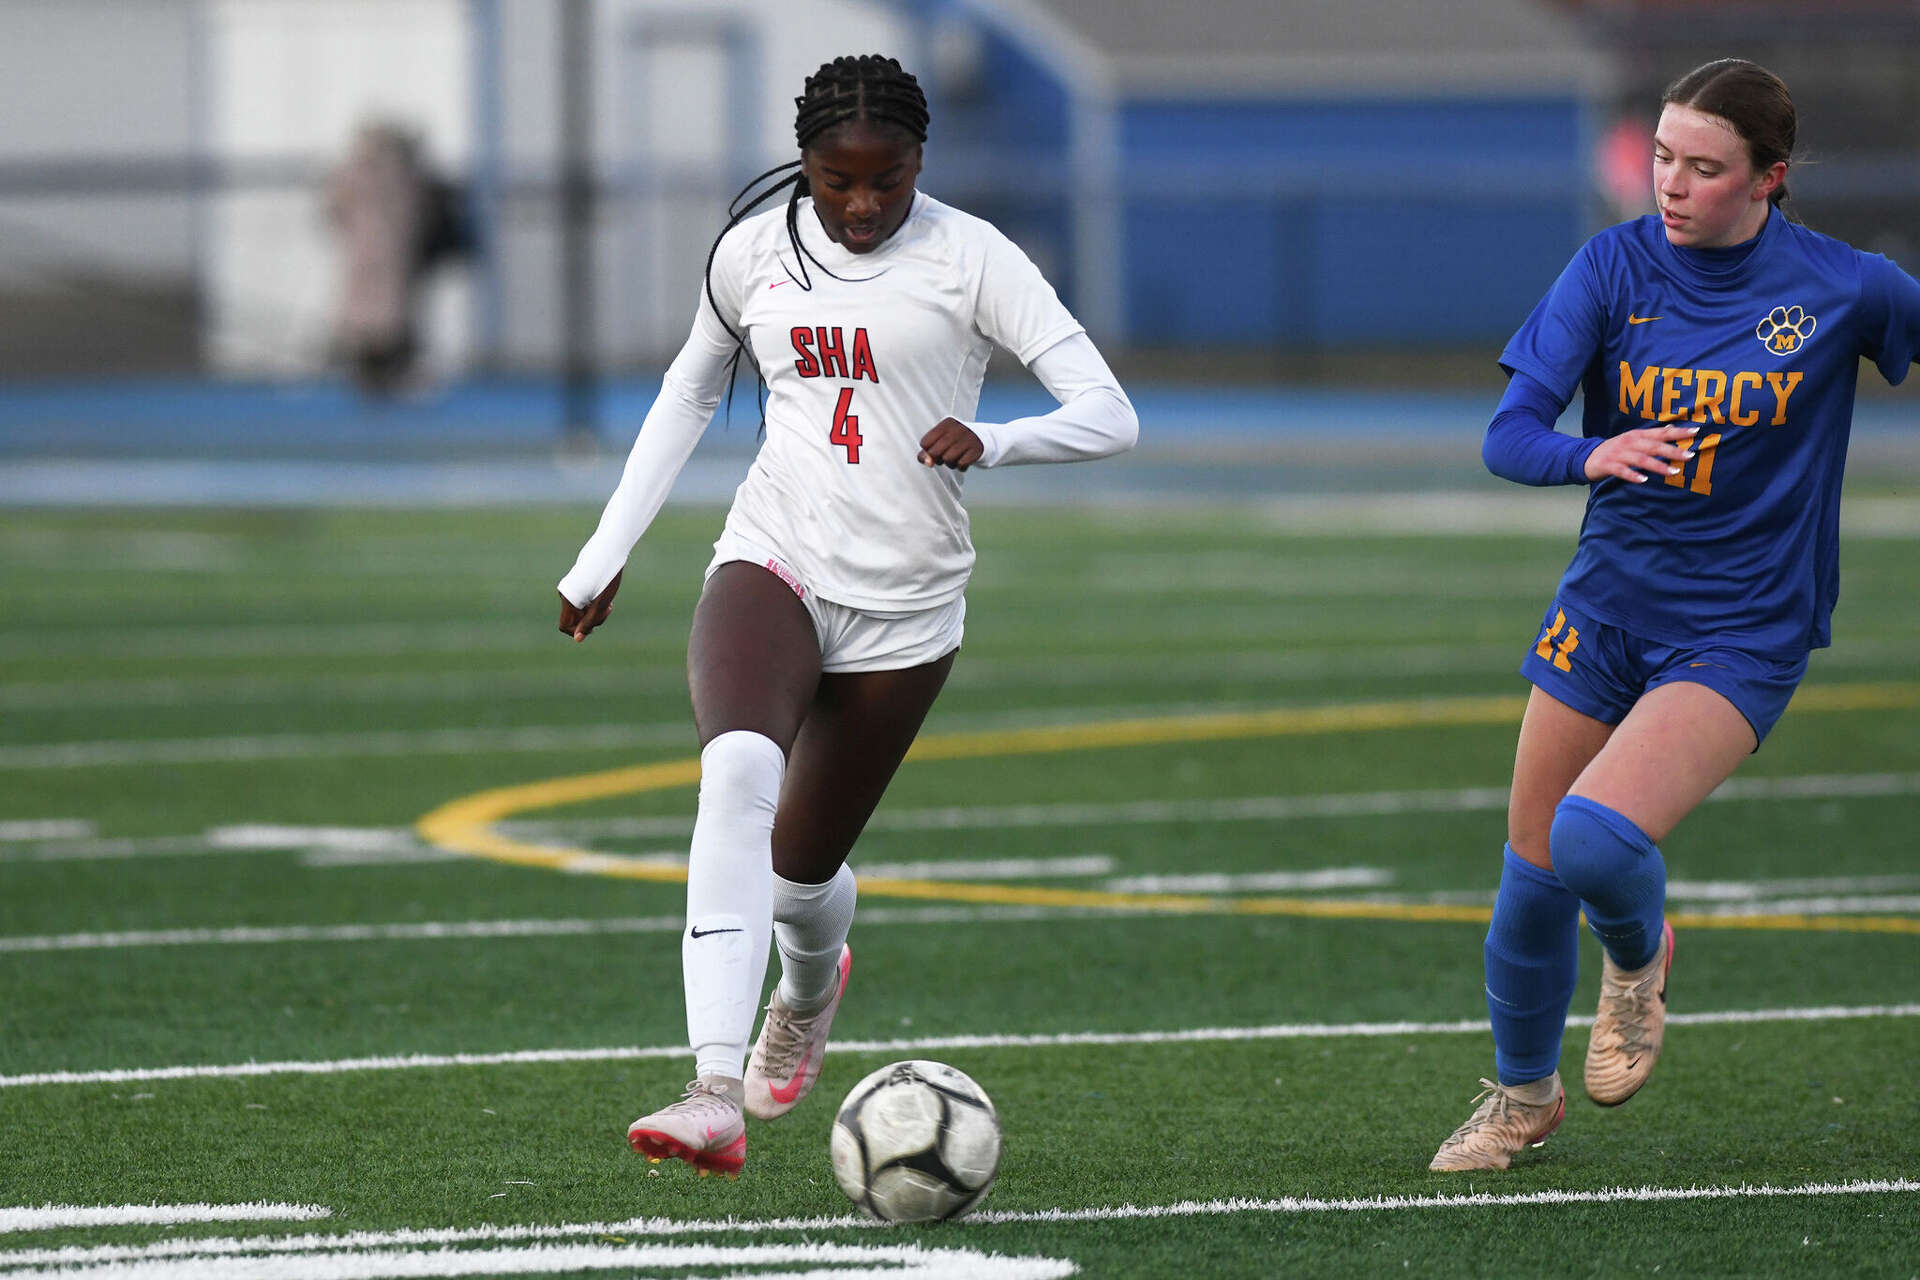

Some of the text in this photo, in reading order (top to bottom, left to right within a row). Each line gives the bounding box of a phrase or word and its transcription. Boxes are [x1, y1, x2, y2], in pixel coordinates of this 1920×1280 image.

[790, 326, 880, 384] SHA
[1774, 334, 1796, 350] M
[1618, 360, 1804, 427] MERCY
[829, 387, 863, 464] 4
